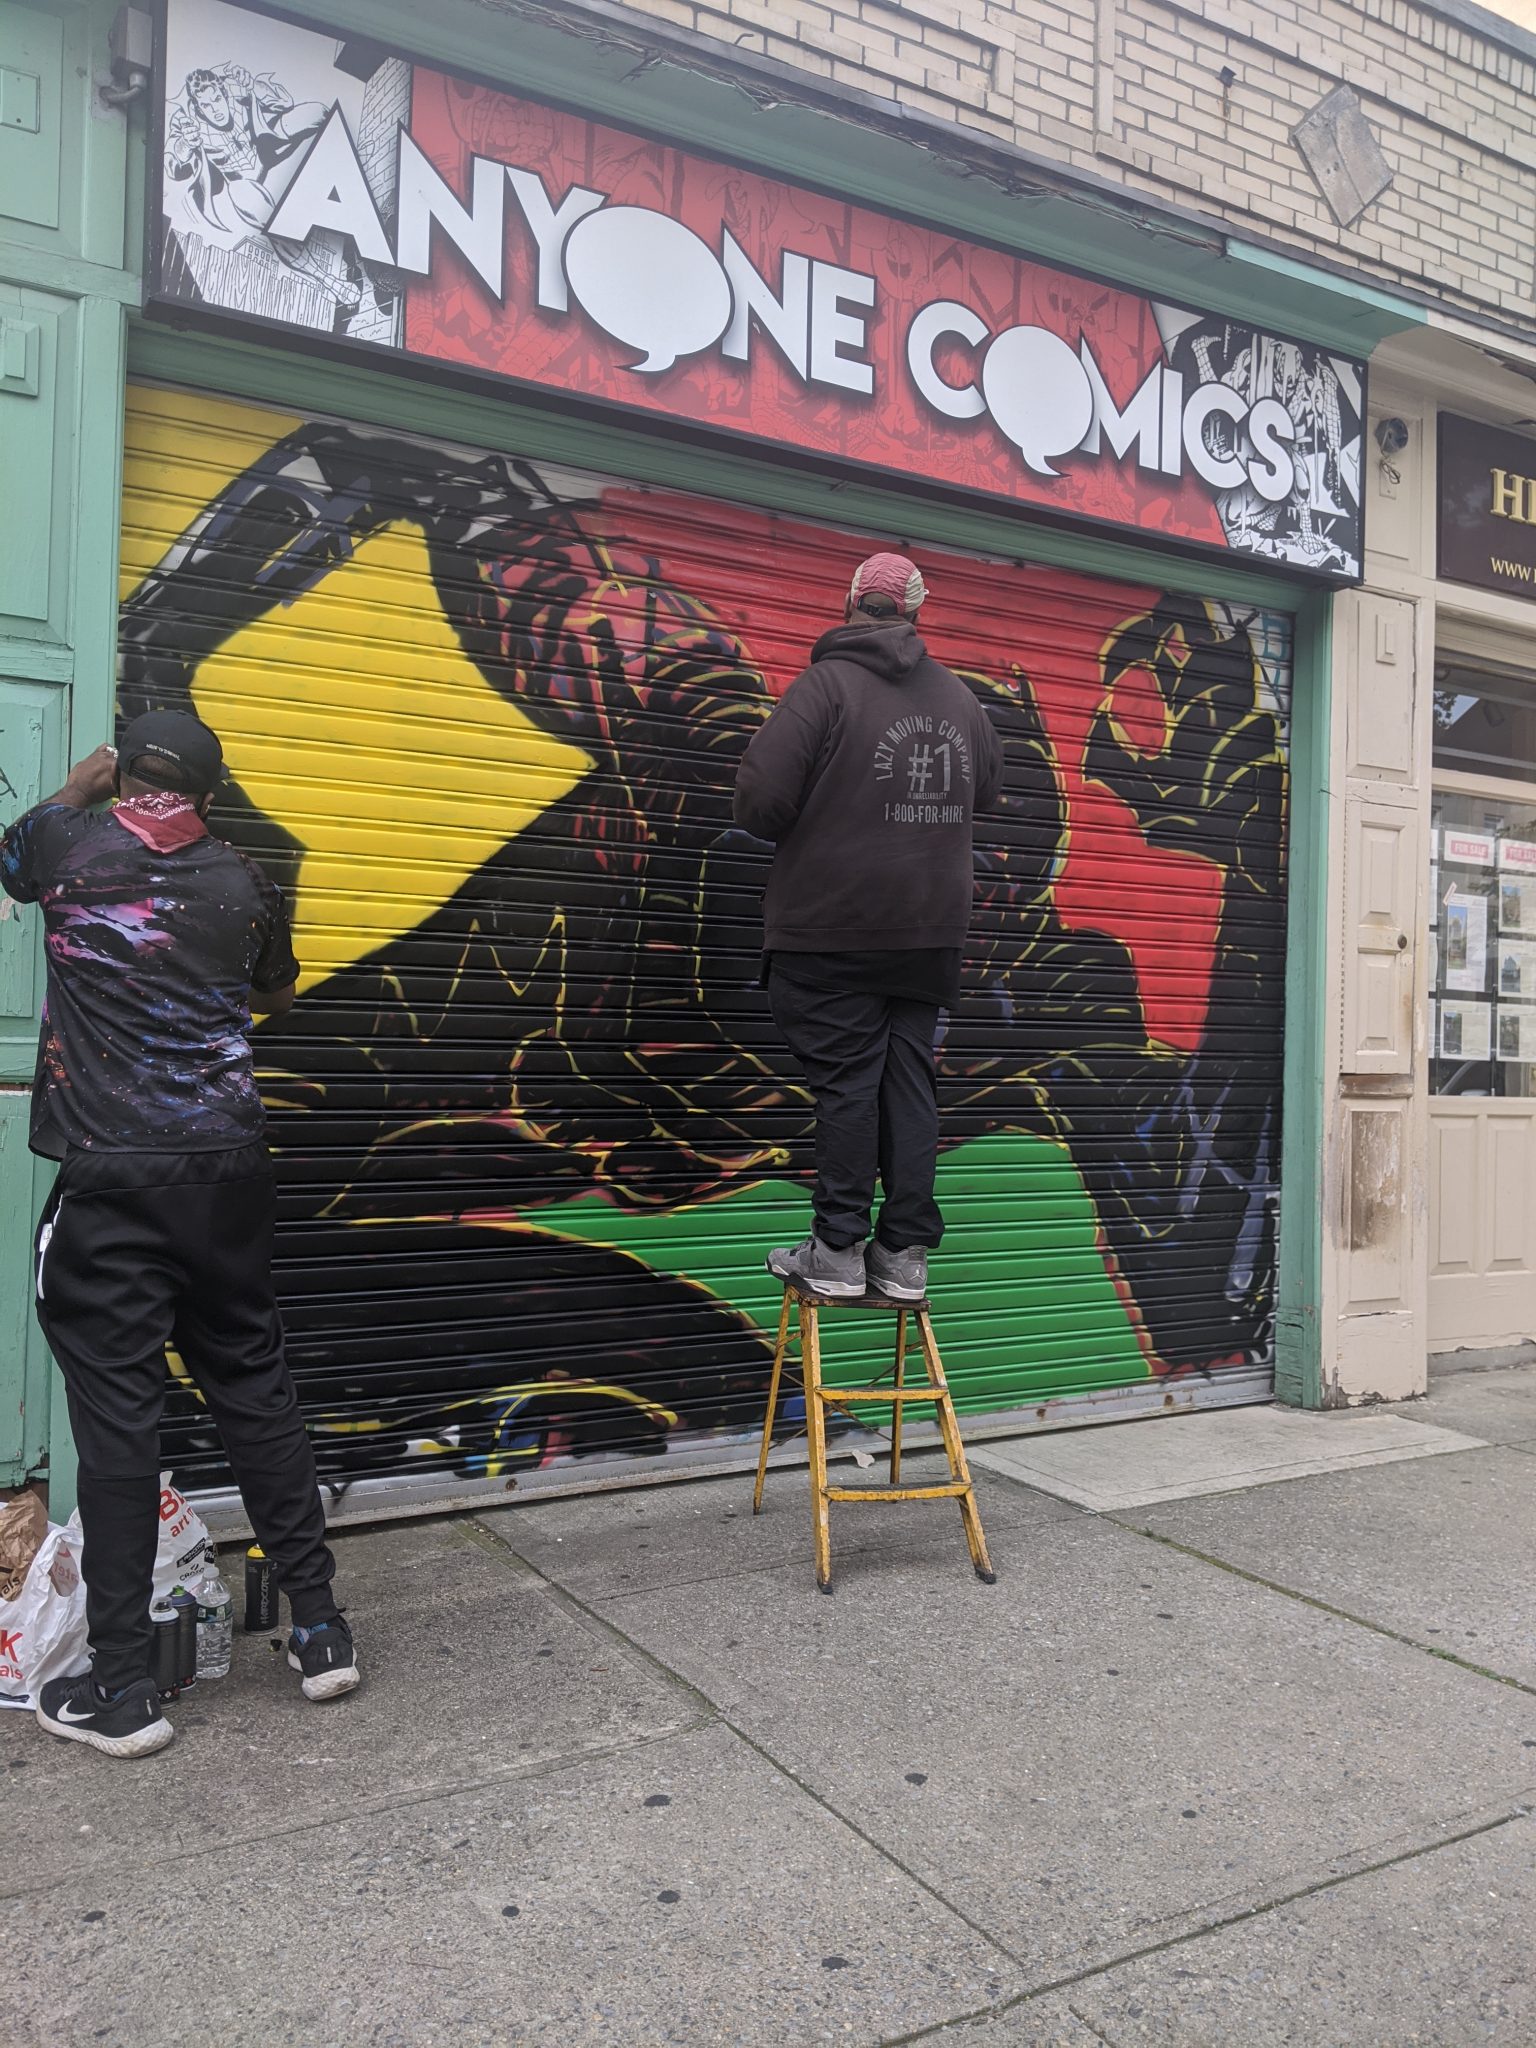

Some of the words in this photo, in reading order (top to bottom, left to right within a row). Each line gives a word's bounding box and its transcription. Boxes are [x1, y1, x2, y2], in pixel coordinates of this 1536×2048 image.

[266, 101, 875, 396] ANYONE
[907, 301, 1295, 501] COMICS
[874, 741, 896, 780] LAZY
[886, 715, 932, 744] MOVING
[938, 719, 970, 783] COMPANY
[907, 743, 951, 792] #1
[912, 792, 947, 800] UNRELIABILITY
[884, 802, 964, 824] 1-800-FOR-HIRE
[1454, 841, 1469, 855] FOR
[1469, 844, 1488, 859] SALE
[170, 1514, 190, 1537] art
